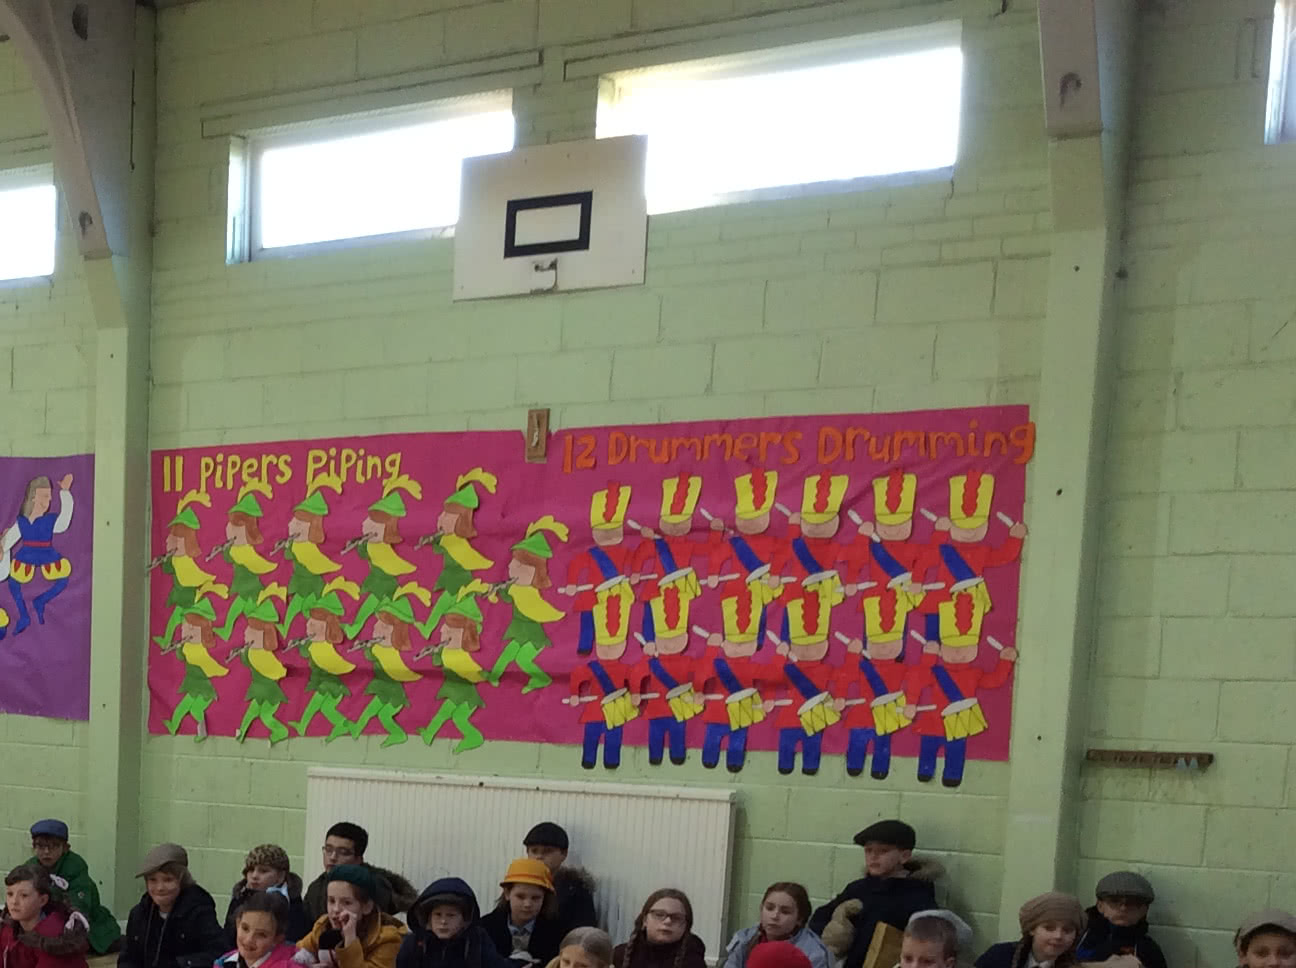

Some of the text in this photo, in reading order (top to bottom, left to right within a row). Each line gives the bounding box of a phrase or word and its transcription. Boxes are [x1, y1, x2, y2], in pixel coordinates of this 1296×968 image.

[563, 419, 1036, 473] 12 Drummers Drumming
[163, 455, 183, 492] 11
[199, 453, 292, 494] Pipers
